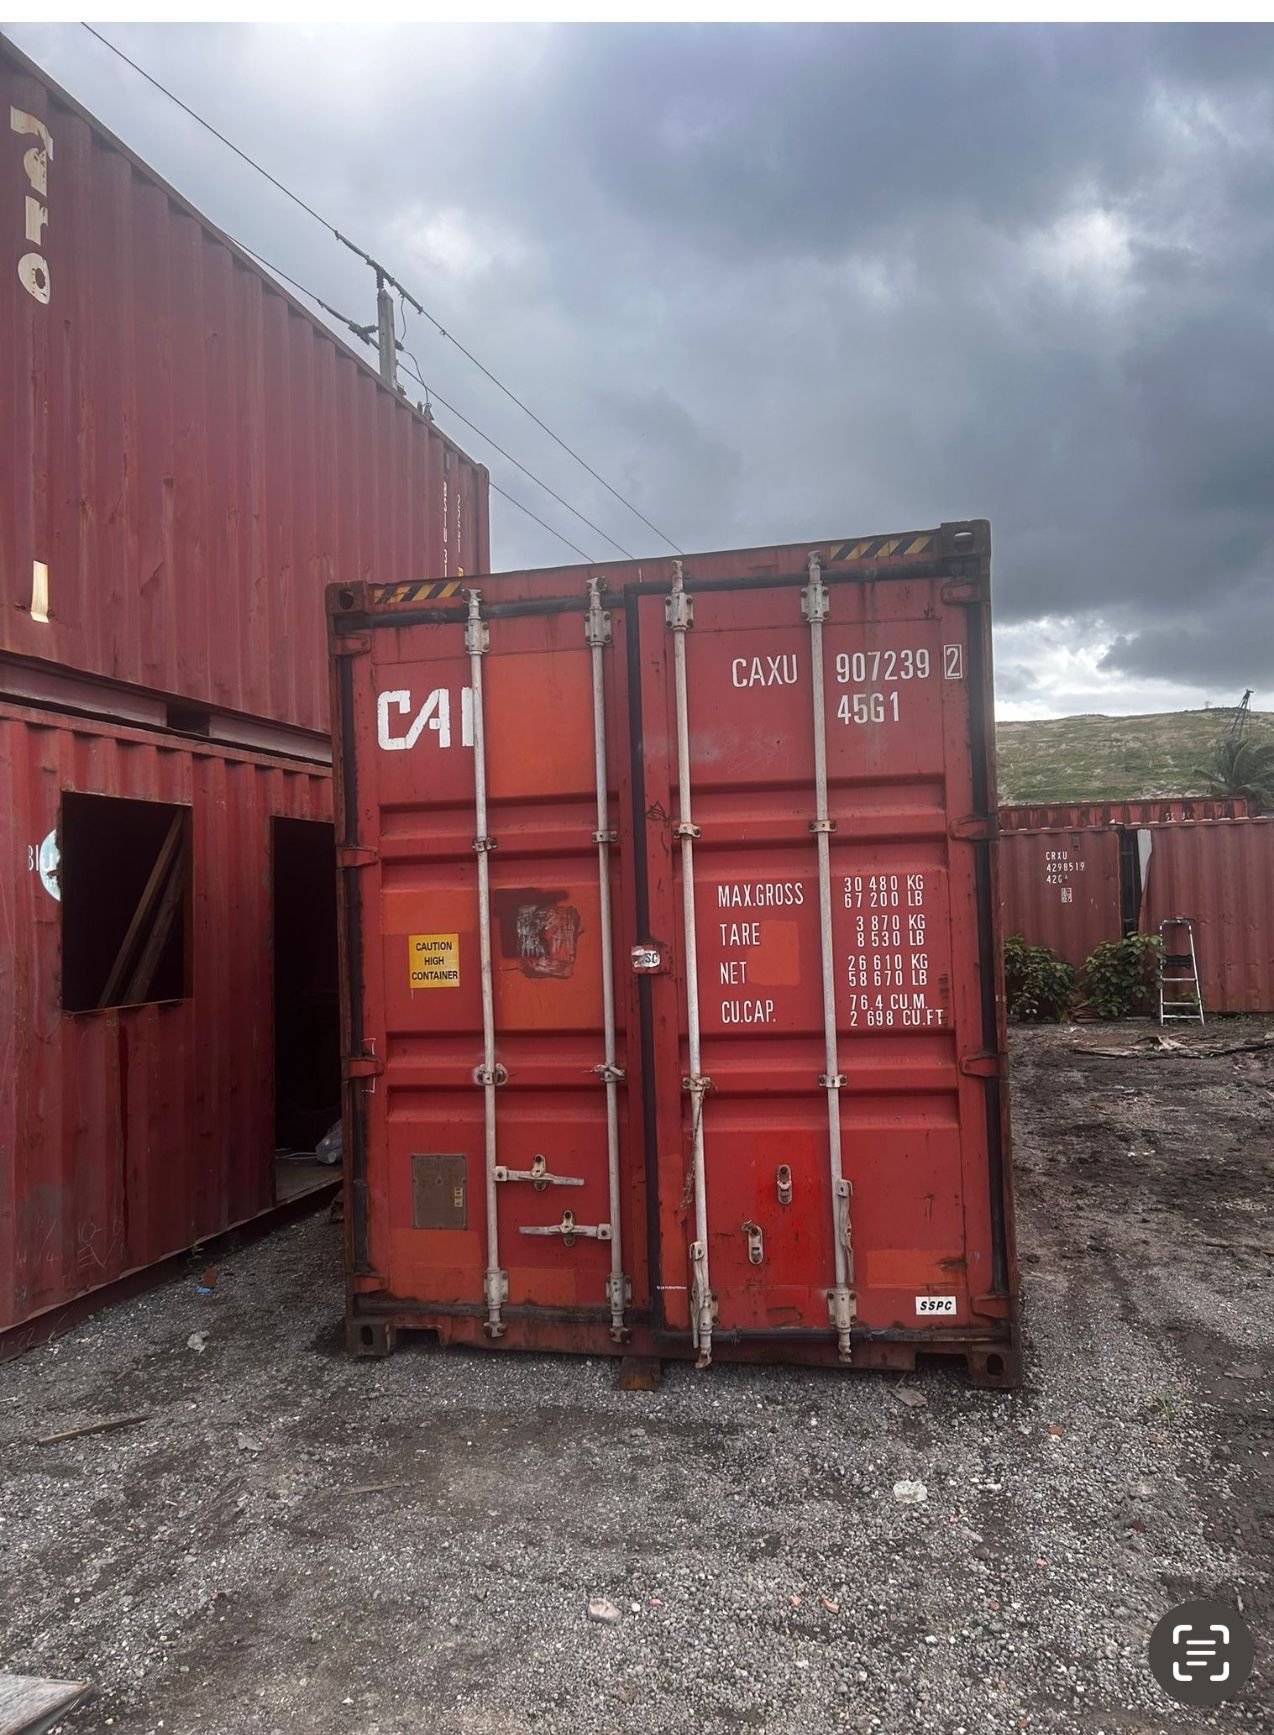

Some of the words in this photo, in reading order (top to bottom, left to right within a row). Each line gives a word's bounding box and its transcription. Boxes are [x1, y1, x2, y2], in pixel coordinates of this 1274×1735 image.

[732, 654, 798, 688] CAXU
[836, 649, 930, 684] 907239
[946, 647, 961, 677] 2
[837, 691, 900, 725] 45G1
[378, 687, 475, 750] CAI
[1045, 851, 1068, 861] CRXU
[1046, 862, 1085, 872] 4298519
[718, 883, 804, 907] MAX.GROSS
[844, 877, 862, 892] 30
[869, 876, 898, 891] 480
[907, 875, 924, 890] KG
[844, 892, 862, 908] 67
[870, 892, 899, 907] 200
[907, 891, 923, 906] LB
[720, 923, 761, 946] TARE
[856, 916, 864, 931] 3
[871, 915, 900, 931] 870
[909, 914, 926, 930] KG
[415, 941, 453, 952] CAUTION
[857, 932, 865, 947] 8
[871, 931, 901, 947] 530
[909, 931, 925, 946] LB
[424, 956, 445, 966] HIGH
[720, 962, 747, 985] NET
[848, 955, 867, 971] 26
[874, 954, 902, 970] 610
[911, 953, 928, 970] KG
[411, 970, 458, 981] CONTAINER
[849, 971, 867, 987] 58
[874, 970, 903, 986] 670
[912, 970, 927, 986] LB
[722, 1000, 776, 1023] CU.CAP.
[850, 995, 883, 1010] 76.4
[890, 993, 928, 1010] CU.M.
[850, 1012, 858, 1027] 2
[867, 1011, 893, 1026] 698
[903, 1009, 944, 1025] CU.FT
[920, 1301, 952, 1311] SSPC
